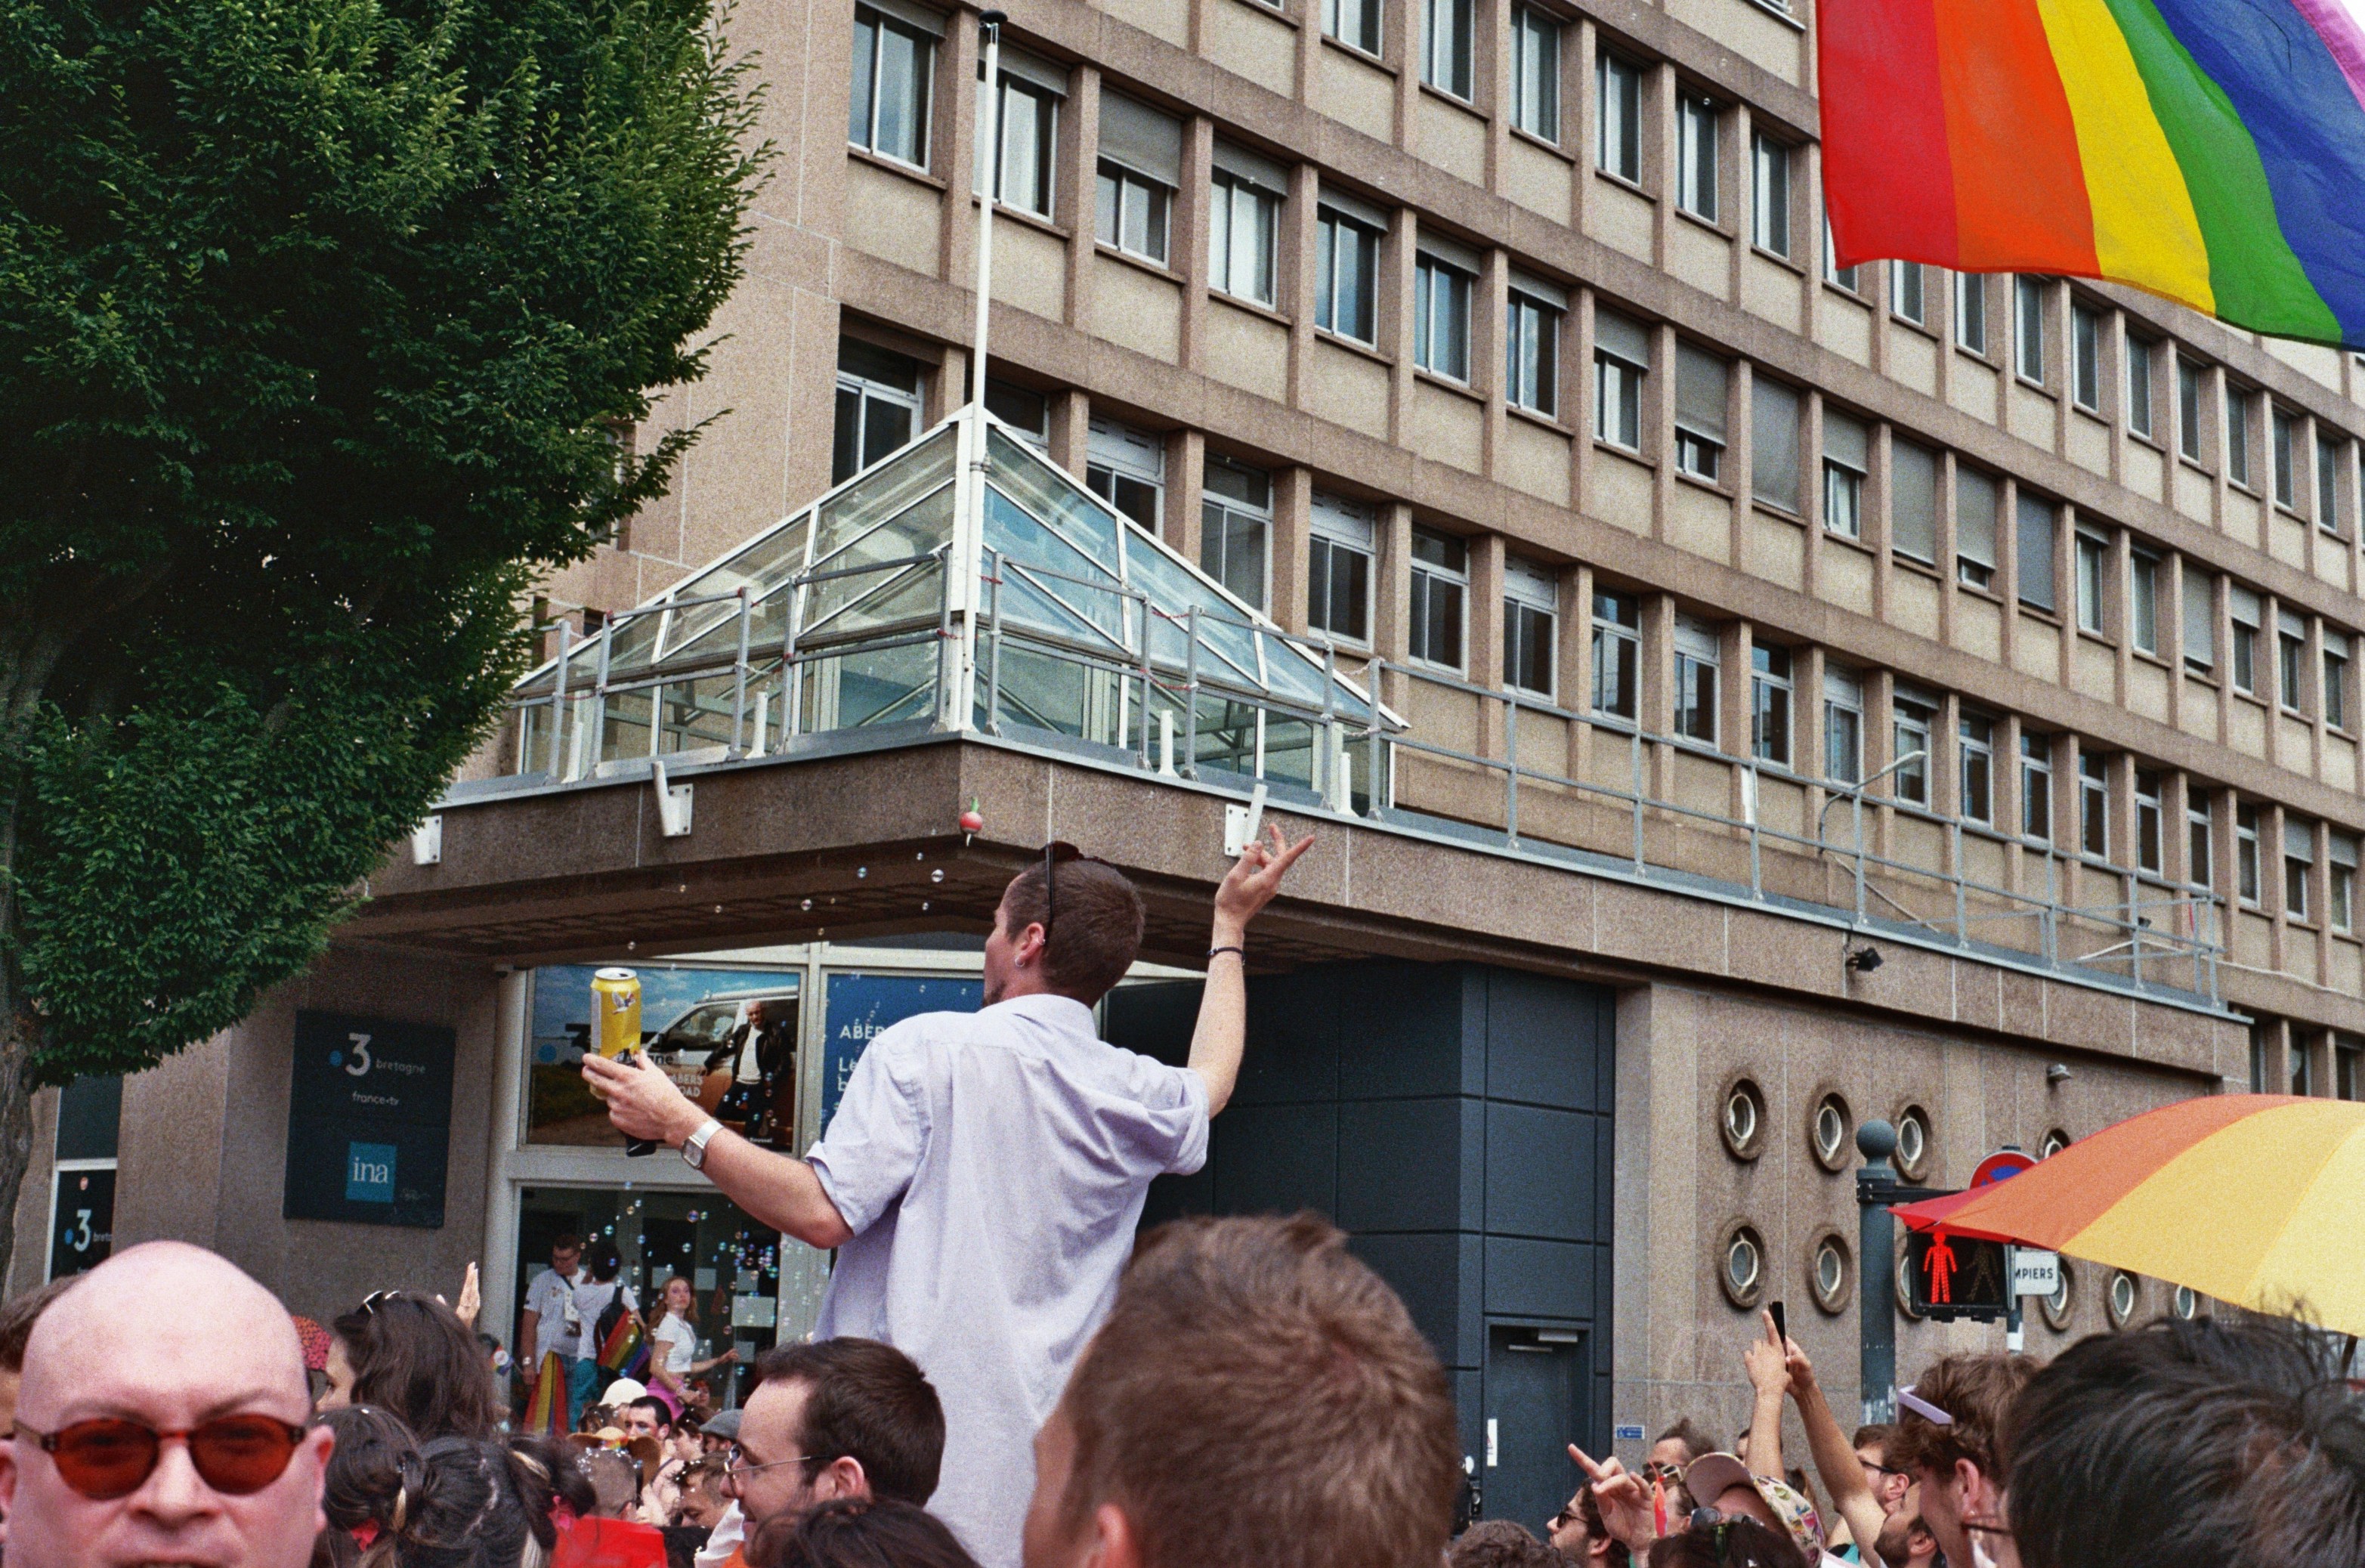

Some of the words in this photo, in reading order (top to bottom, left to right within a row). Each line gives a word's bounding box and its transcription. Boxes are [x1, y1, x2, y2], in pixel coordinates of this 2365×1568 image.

[345, 1033, 371, 1077] 3
[375, 1058, 426, 1076] bretagne
[352, 1156, 388, 1184] ina
[74, 1209, 91, 1252] 3
